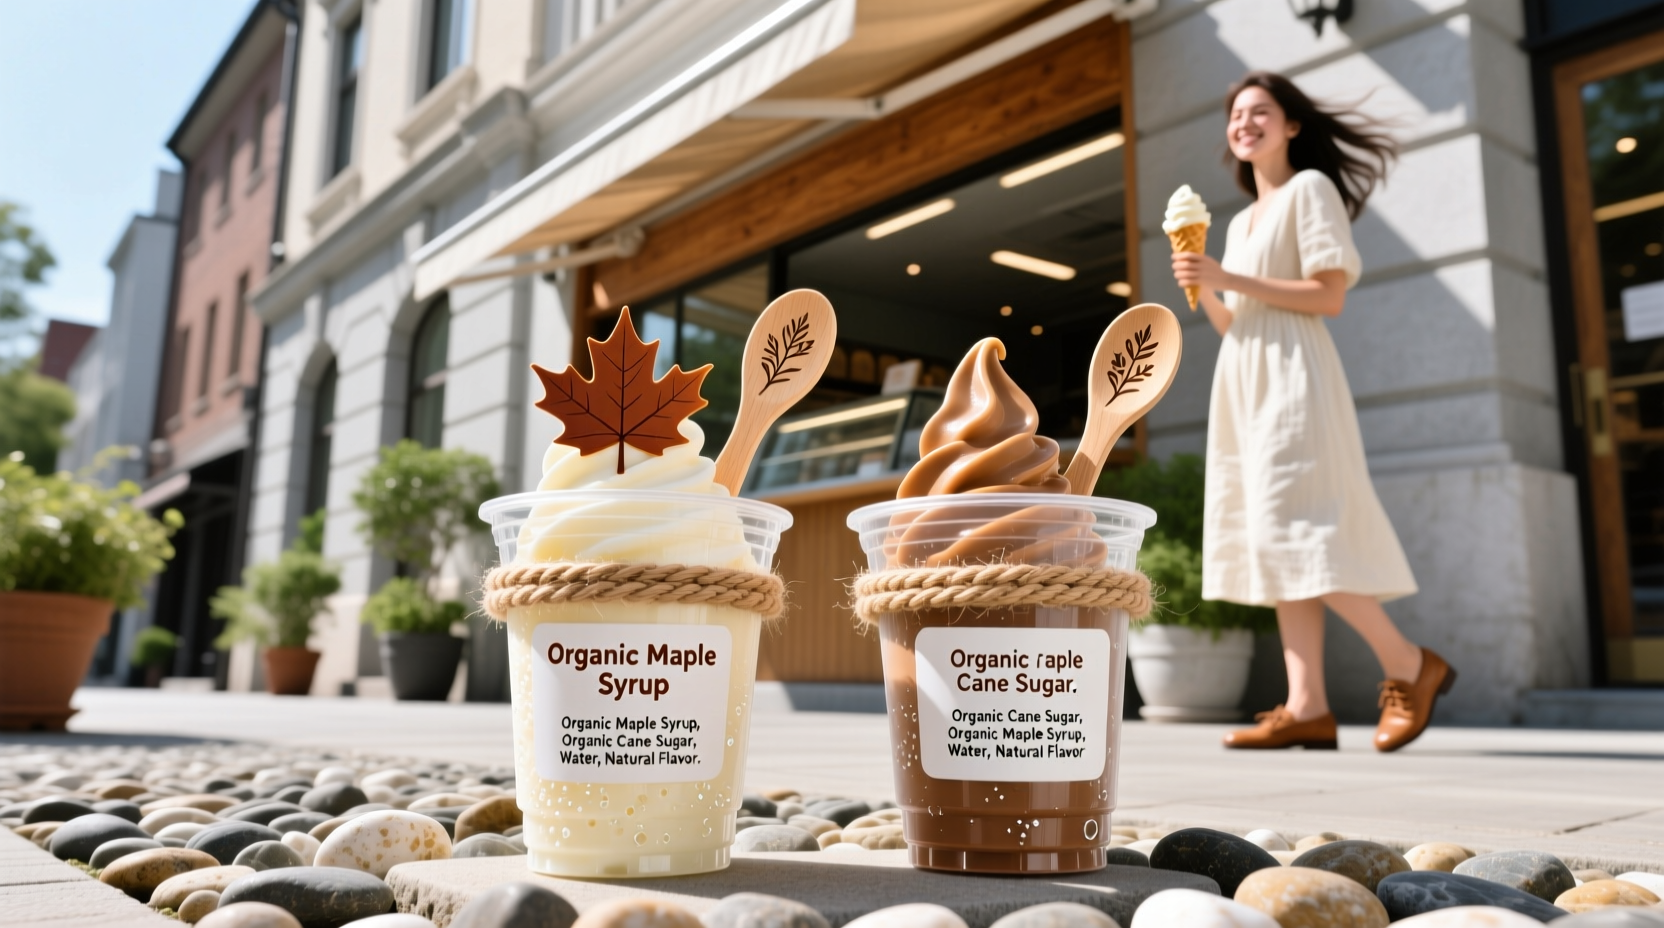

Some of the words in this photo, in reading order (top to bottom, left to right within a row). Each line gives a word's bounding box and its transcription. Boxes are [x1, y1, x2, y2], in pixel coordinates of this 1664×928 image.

[548, 643, 638, 671] Organic
[647, 643, 716, 672] Maple
[951, 649, 1028, 674] Organic
[599, 673, 669, 701] Syrup
[957, 673, 1008, 692] Cane
[562, 716, 611, 732] Organic
[616, 716, 656, 733] Maple
[661, 716, 700, 733] Syrup,
[952, 709, 1003, 725] Organic
[1008, 709, 1040, 722] Cane
[1045, 710, 1082, 725] Sugar,
[562, 734, 612, 750] Organic
[617, 735, 651, 747] Cane
[656, 735, 696, 750] Sugar,
[948, 726, 998, 742] Organic
[1003, 727, 1043, 742] Maple
[1047, 727, 1085, 743] Syrup,
[560, 751, 601, 767] Water,
[605, 751, 654, 765] Natural
[659, 751, 700, 764] Flavor.
[948, 743, 990, 760] Water,
[996, 744, 1043, 758] Natural
[1048, 744, 1085, 758] Flavor
